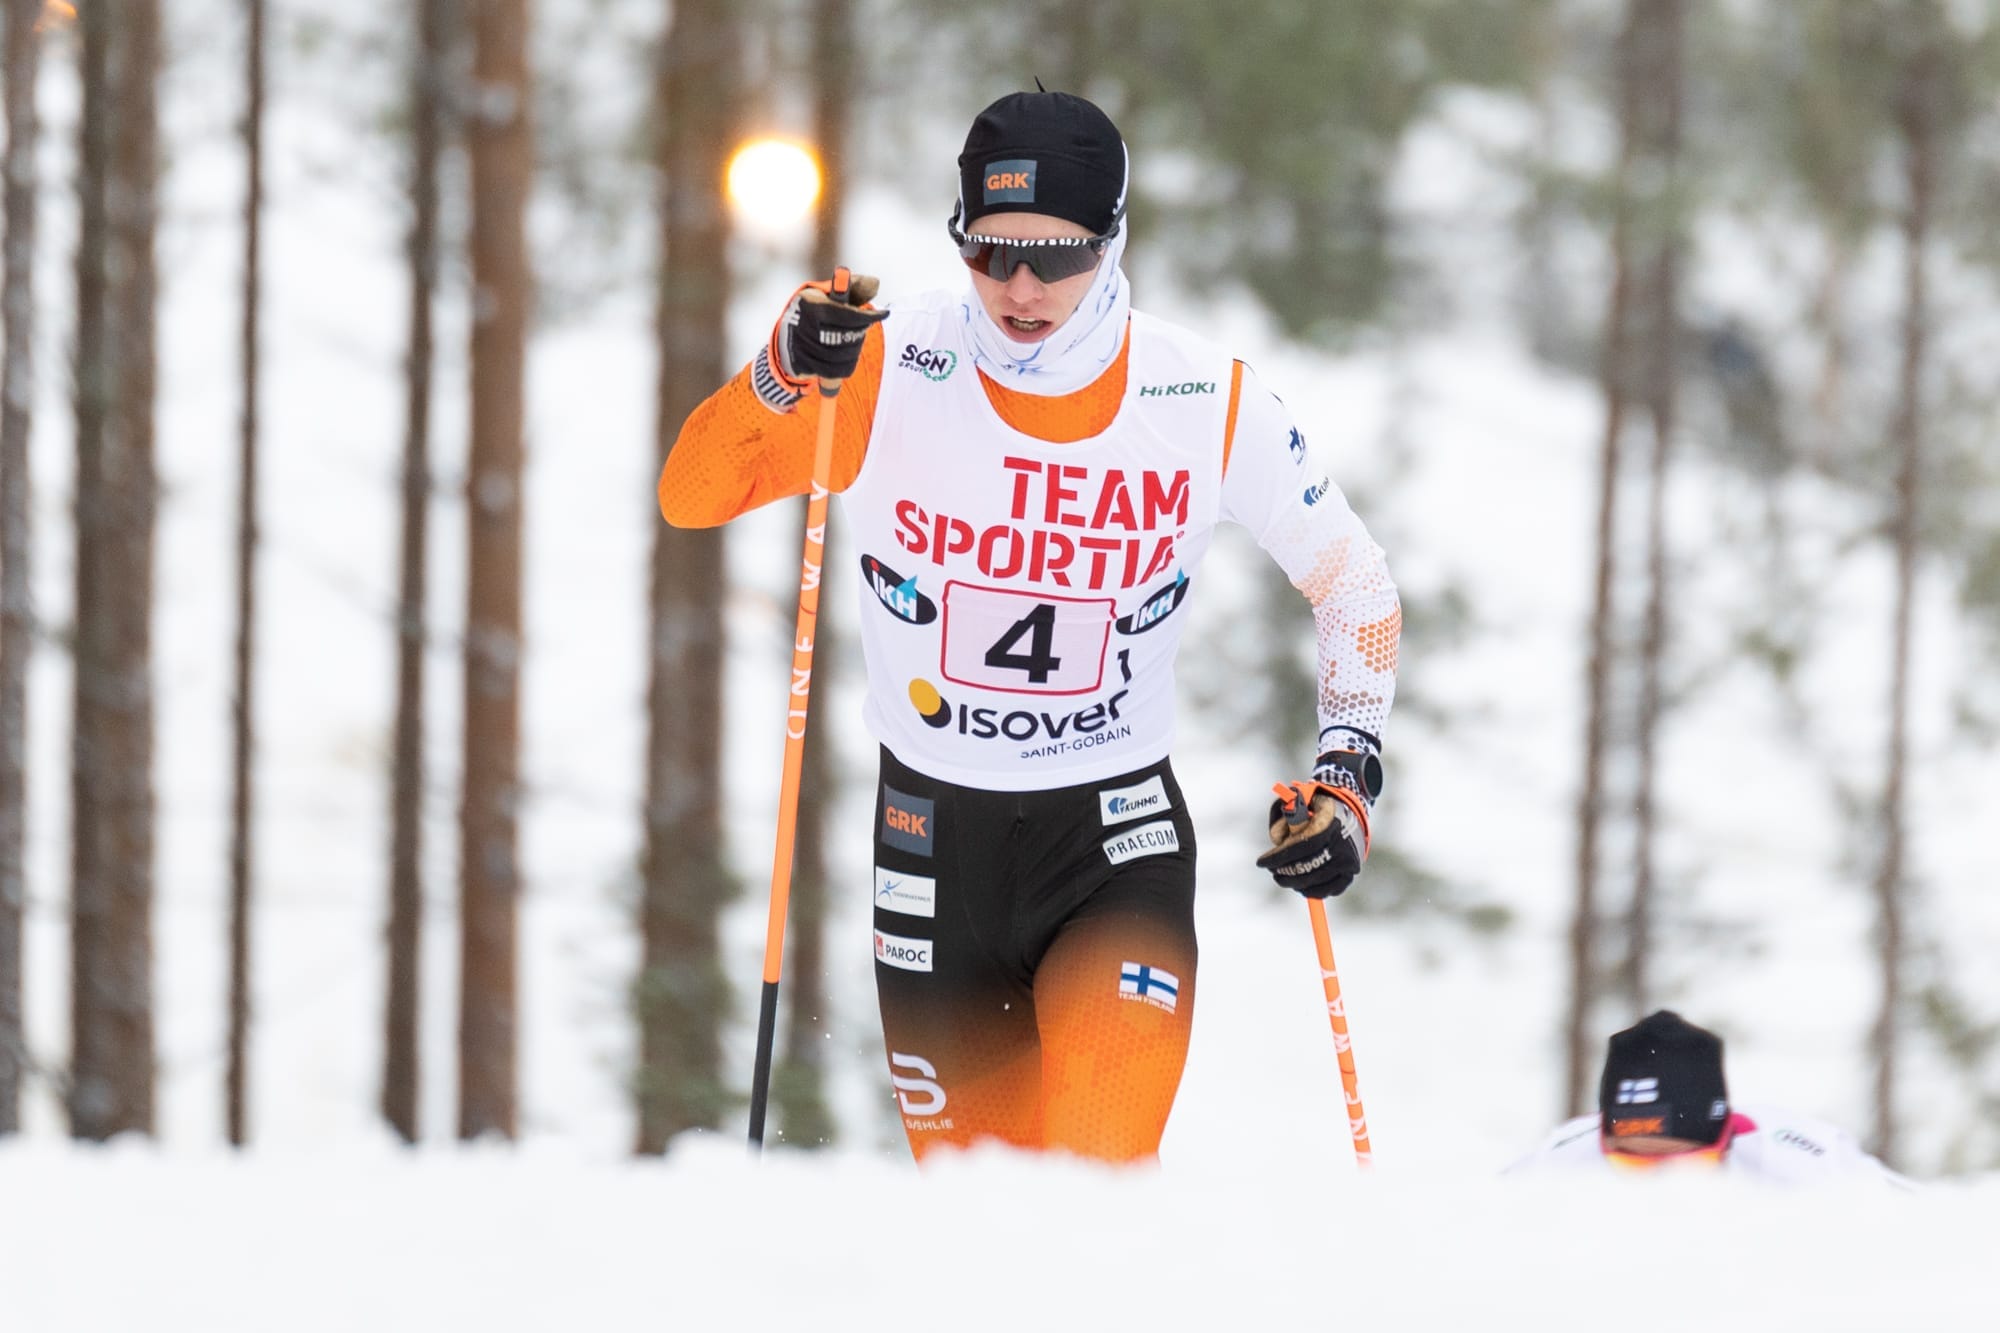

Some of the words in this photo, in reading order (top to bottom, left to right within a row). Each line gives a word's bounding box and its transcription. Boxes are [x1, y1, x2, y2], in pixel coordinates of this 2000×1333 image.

[986, 172, 1029, 190] GRK
[901, 344, 948, 373] SGN
[1004, 456, 1190, 531] TEAM
[801, 480, 829, 591] WAY
[894, 499, 1175, 590] SPORTIA
[984, 603, 1062, 684] 4
[1117, 648, 1132, 684] 1
[1020, 725, 1132, 759] SAINT-GOBAIN
[886, 805, 927, 838] GRK
[1106, 828, 1177, 859] PRAECOM
[886, 944, 927, 964] PAROC
[1118, 992, 1142, 1003] TEAM
